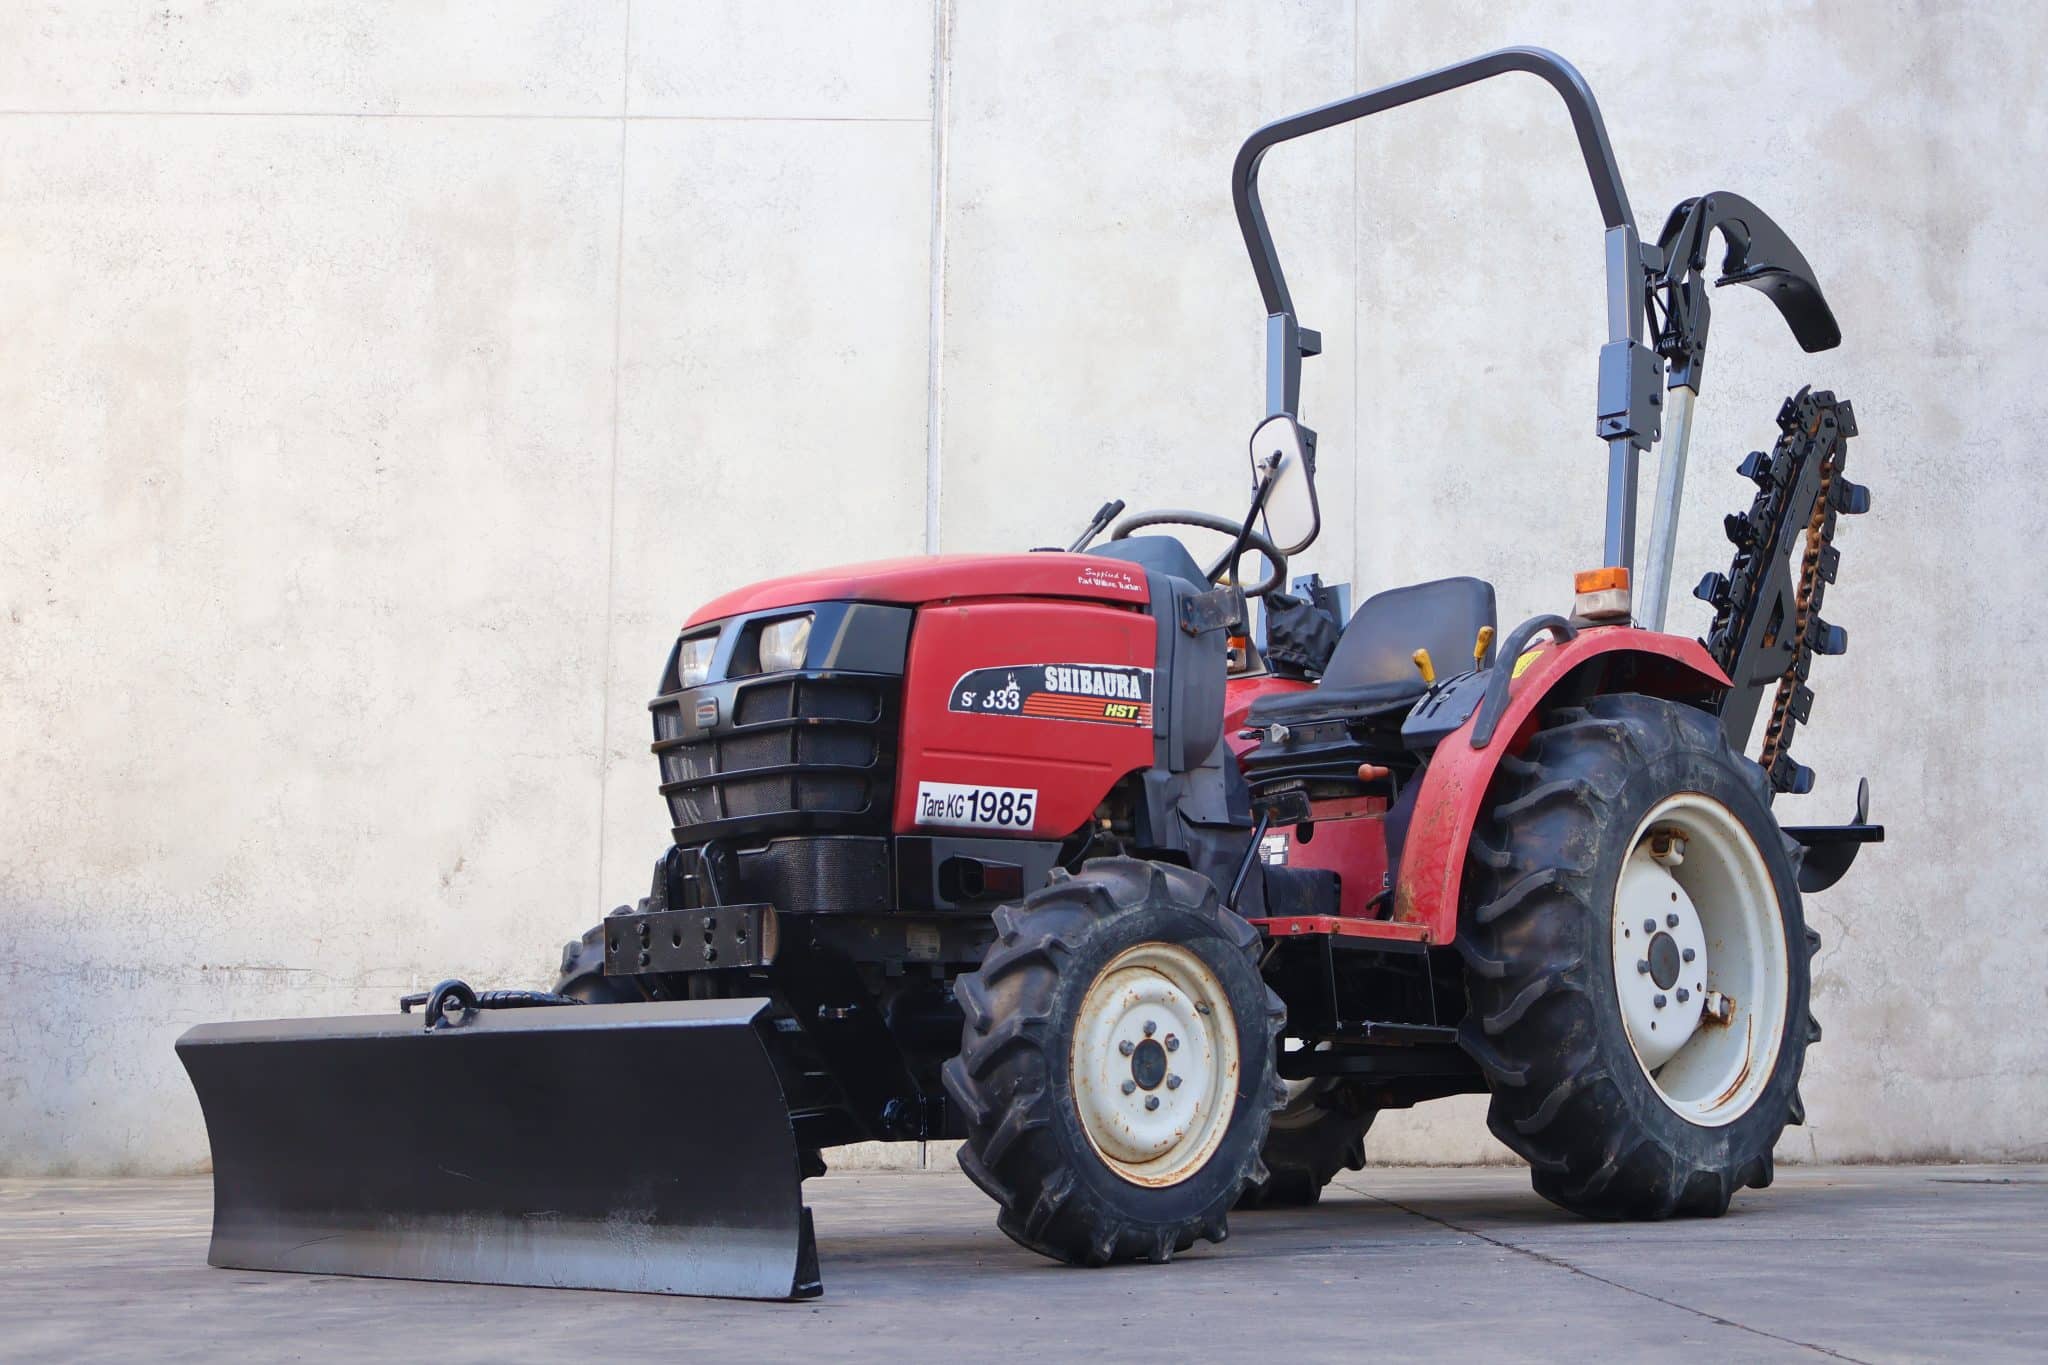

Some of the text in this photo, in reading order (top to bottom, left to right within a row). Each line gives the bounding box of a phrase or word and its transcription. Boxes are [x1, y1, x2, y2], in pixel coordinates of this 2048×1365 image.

[1123, 573, 1131, 583] by
[1045, 667, 1141, 700] SHIBAURA
[983, 690, 1019, 710] 333
[1105, 703, 1138, 718] HST
[922, 788, 1033, 826] Tare KG 1985
